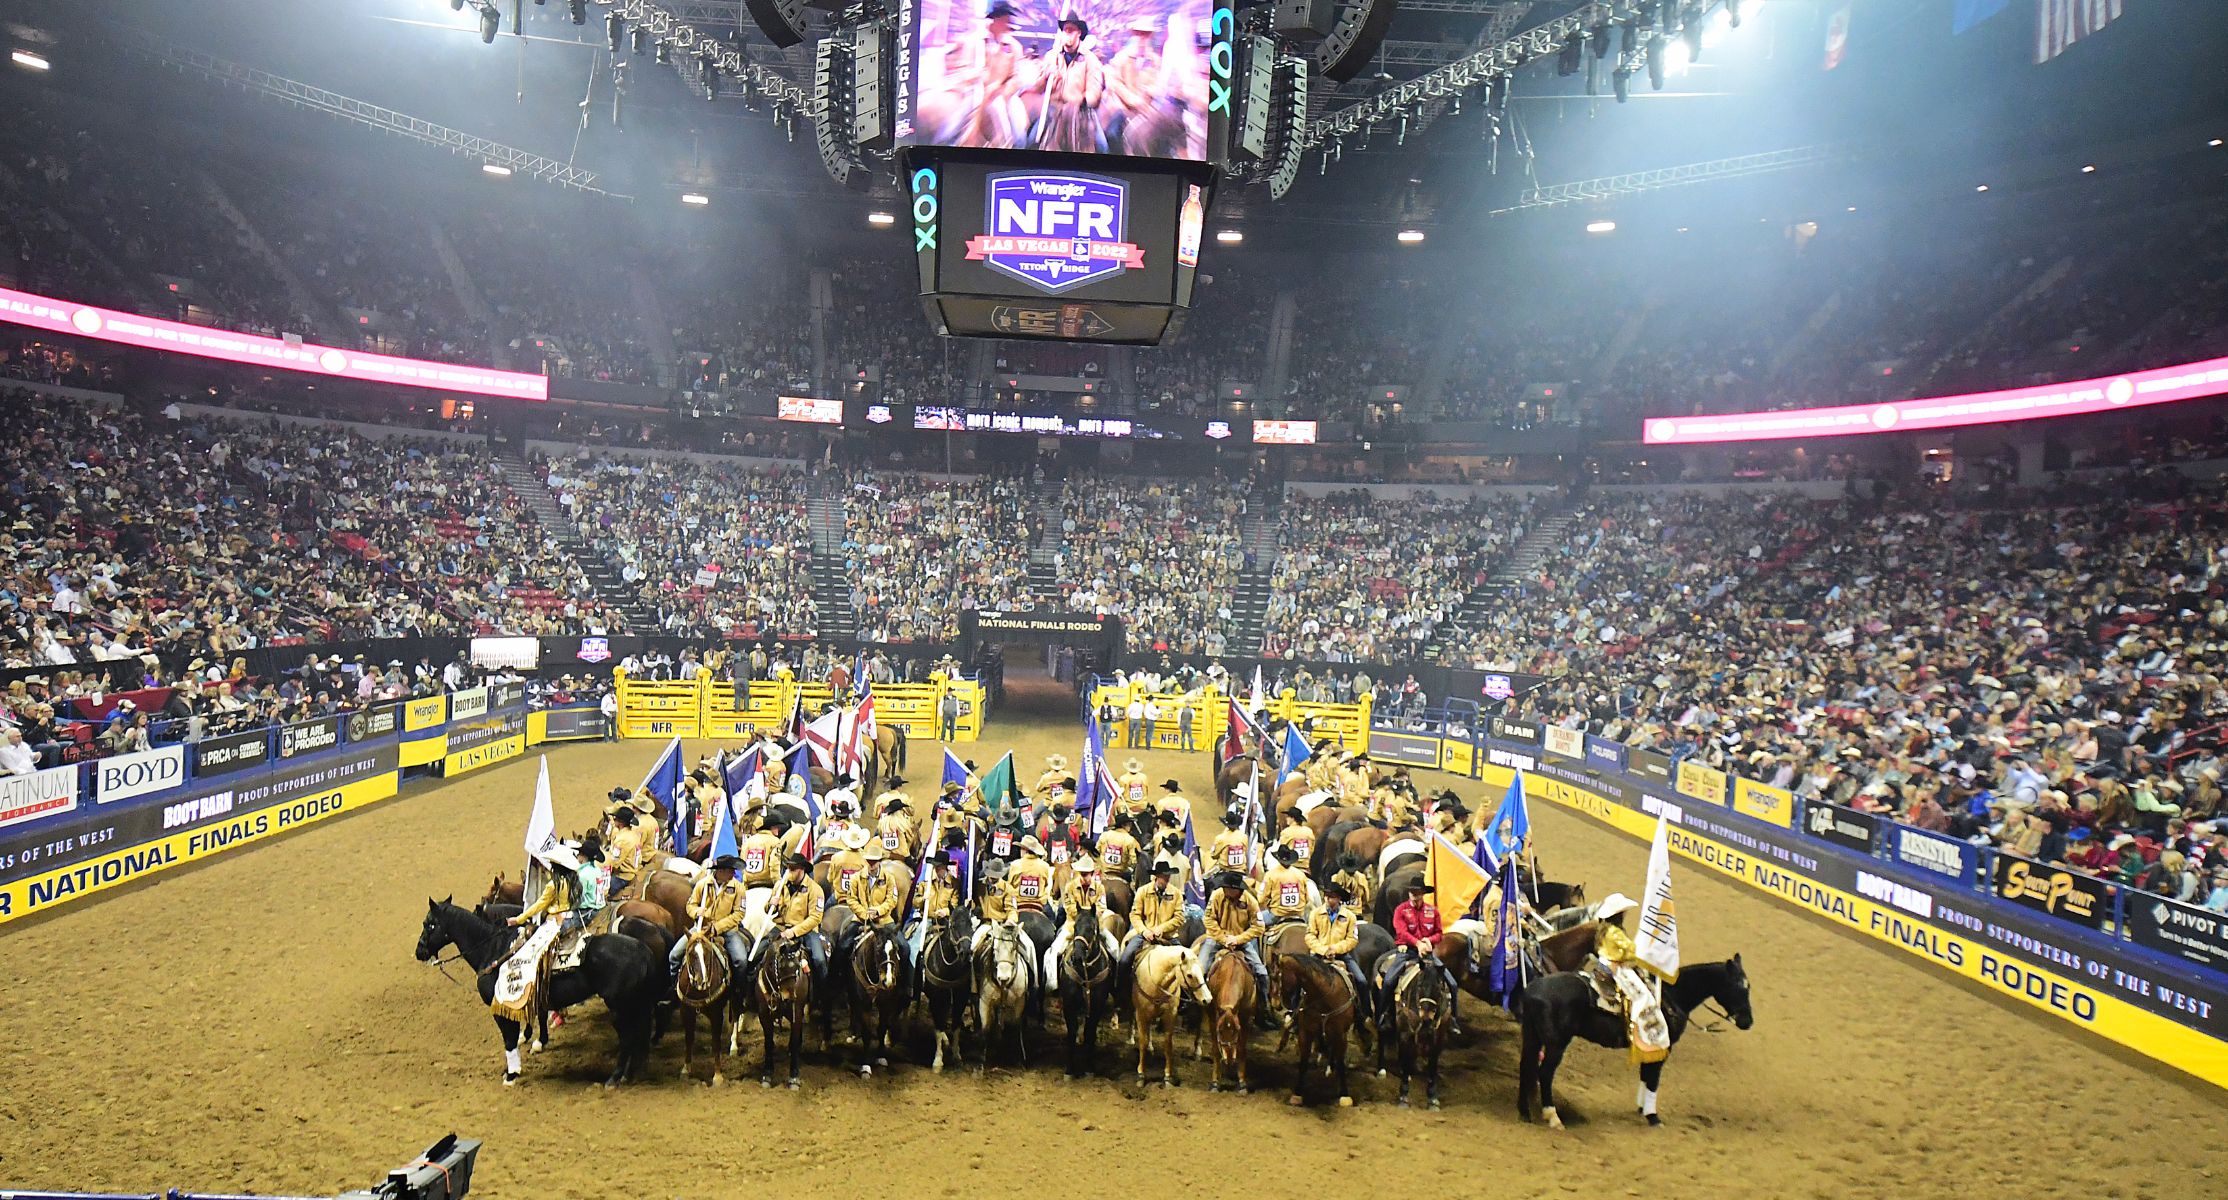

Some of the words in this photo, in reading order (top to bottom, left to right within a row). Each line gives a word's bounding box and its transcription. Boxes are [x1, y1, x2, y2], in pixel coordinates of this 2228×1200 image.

[898, 32, 911, 115] VEGAS
[1208, 8, 1234, 118] COX
[1030, 181, 1086, 201] Wrangler
[912, 168, 937, 252] COX
[998, 198, 1114, 238] NFR
[983, 240, 1013, 251] LAS
[1017, 240, 1068, 253] VEGAS
[1093, 244, 1128, 258] 2022
[1019, 263, 1047, 271] TETON
[1062, 264, 1090, 273] RIDGE
[978, 619, 1029, 629] NATIONAL
[1031, 621, 1065, 630] FINALS
[1067, 622, 1102, 631] RODEO
[414, 703, 439, 721] Wrangler
[455, 698, 470, 712] BOOT
[470, 695, 485, 709] BARN
[295, 727, 308, 740] WE
[309, 724, 325, 736] ARE
[652, 722, 673, 733] NFR
[735, 723, 755, 734] NFR
[1160, 734, 1179, 744] NFR
[1504, 724, 1535, 739] RAM
[295, 732, 336, 751] PRORODEO
[207, 747, 231, 765] PRCA
[460, 753, 480, 769] LAS
[484, 742, 516, 760] VEGAS
[104, 757, 178, 792] BOYD
[1538, 762, 1557, 775] PROUD
[1557, 768, 1590, 785] SUPPORTERS
[0, 769, 69, 809] ATINUM
[163, 800, 200, 830] BOOT
[199, 791, 234, 819] BARN
[239, 787, 269, 804] PROUD
[273, 772, 325, 795] SUPPORTERS
[328, 767, 338, 779] OF
[340, 763, 354, 777] THE
[357, 758, 377, 773] WEST
[1546, 781, 1569, 800] LAS
[1574, 791, 1611, 817] VEGAS
[1747, 788, 1780, 813] Wrangler
[21, 847, 39, 864] OF
[46, 838, 73, 857] THE
[79, 827, 115, 847] WEST
[29, 843, 178, 907] NATIONAL
[189, 816, 268, 855] FINALS
[279, 792, 343, 826] RODEO
[1685, 813, 1708, 831] PROUD
[1710, 822, 1757, 849] SUPPORTERS
[1759, 840, 1770, 853] OF
[1773, 846, 1790, 862] THE
[1792, 851, 1818, 872] WEST
[1900, 829, 1963, 870] RESISTOL
[2046, 872, 2096, 914] POINT
[2171, 909, 2217, 935] PIVOT
[1754, 864, 1859, 923] NATIONAL
[1871, 910, 1965, 967] FINALS
[1980, 954, 2097, 1021] RODEO
[1937, 904, 1983, 932] PROUD
[1986, 923, 2081, 970] SUPPORTERS
[2086, 958, 2109, 980] OF
[2114, 969, 2150, 997] THE
[2157, 985, 2212, 1019] WEST
